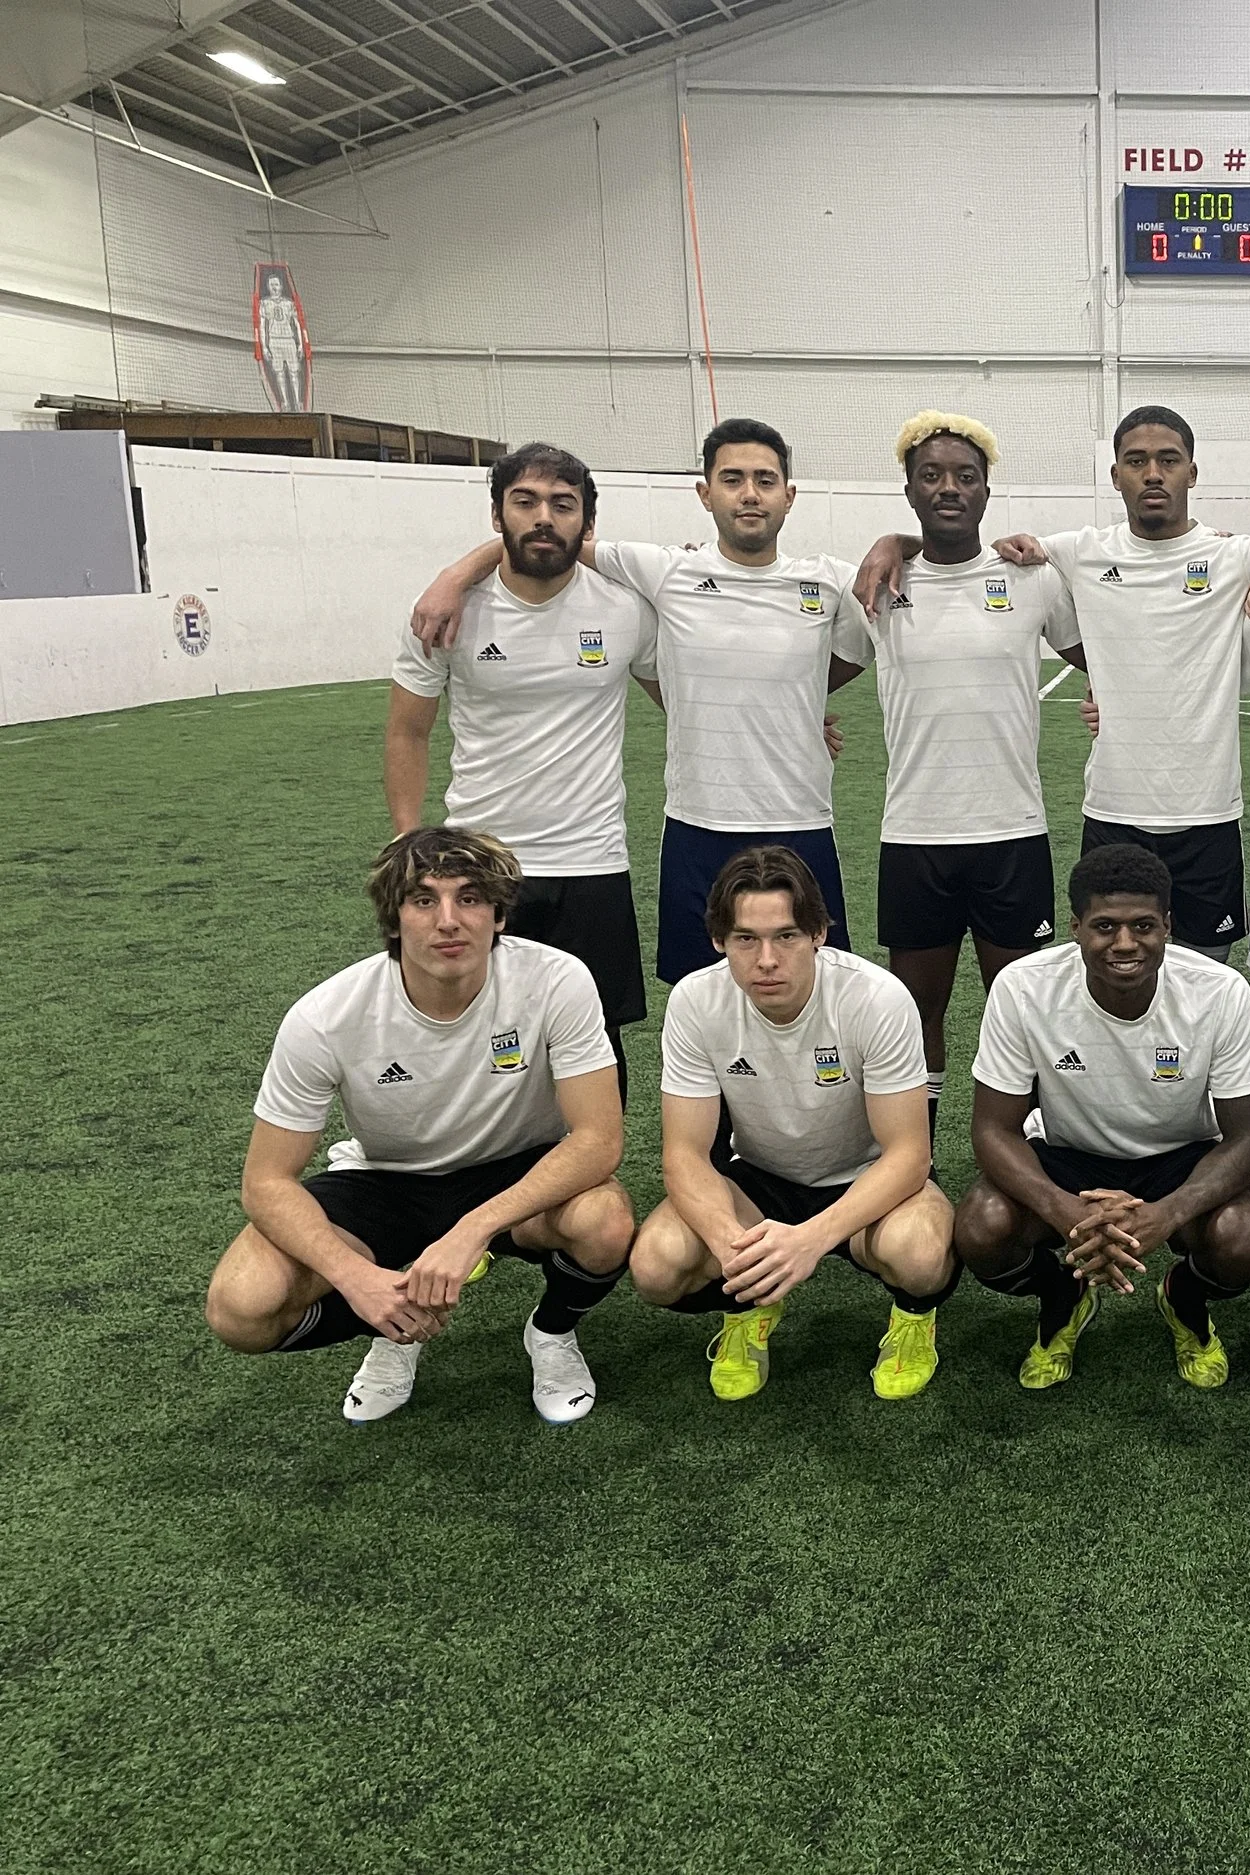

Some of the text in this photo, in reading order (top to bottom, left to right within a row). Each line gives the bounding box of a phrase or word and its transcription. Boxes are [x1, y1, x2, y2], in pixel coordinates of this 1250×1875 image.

[1124, 148, 1203, 172] FIELD
[1174, 193, 1233, 221] 0:00
[1136, 222, 1165, 231] HOME
[1152, 234, 1168, 262] 0
[1177, 252, 1212, 260] PENALTY
[1188, 564, 1207, 573] CITY
[987, 585, 1005, 593] CITY
[184, 613, 201, 638] E
[581, 637, 601, 645] CITY
[493, 1037, 518, 1051] CITY
[816, 1054, 838, 1063] CITY
[1156, 1053, 1178, 1061] CITY
[1055, 1063, 1086, 1071] adidas
[726, 1068, 757, 1076] adidas
[377, 1074, 413, 1085] adidas
